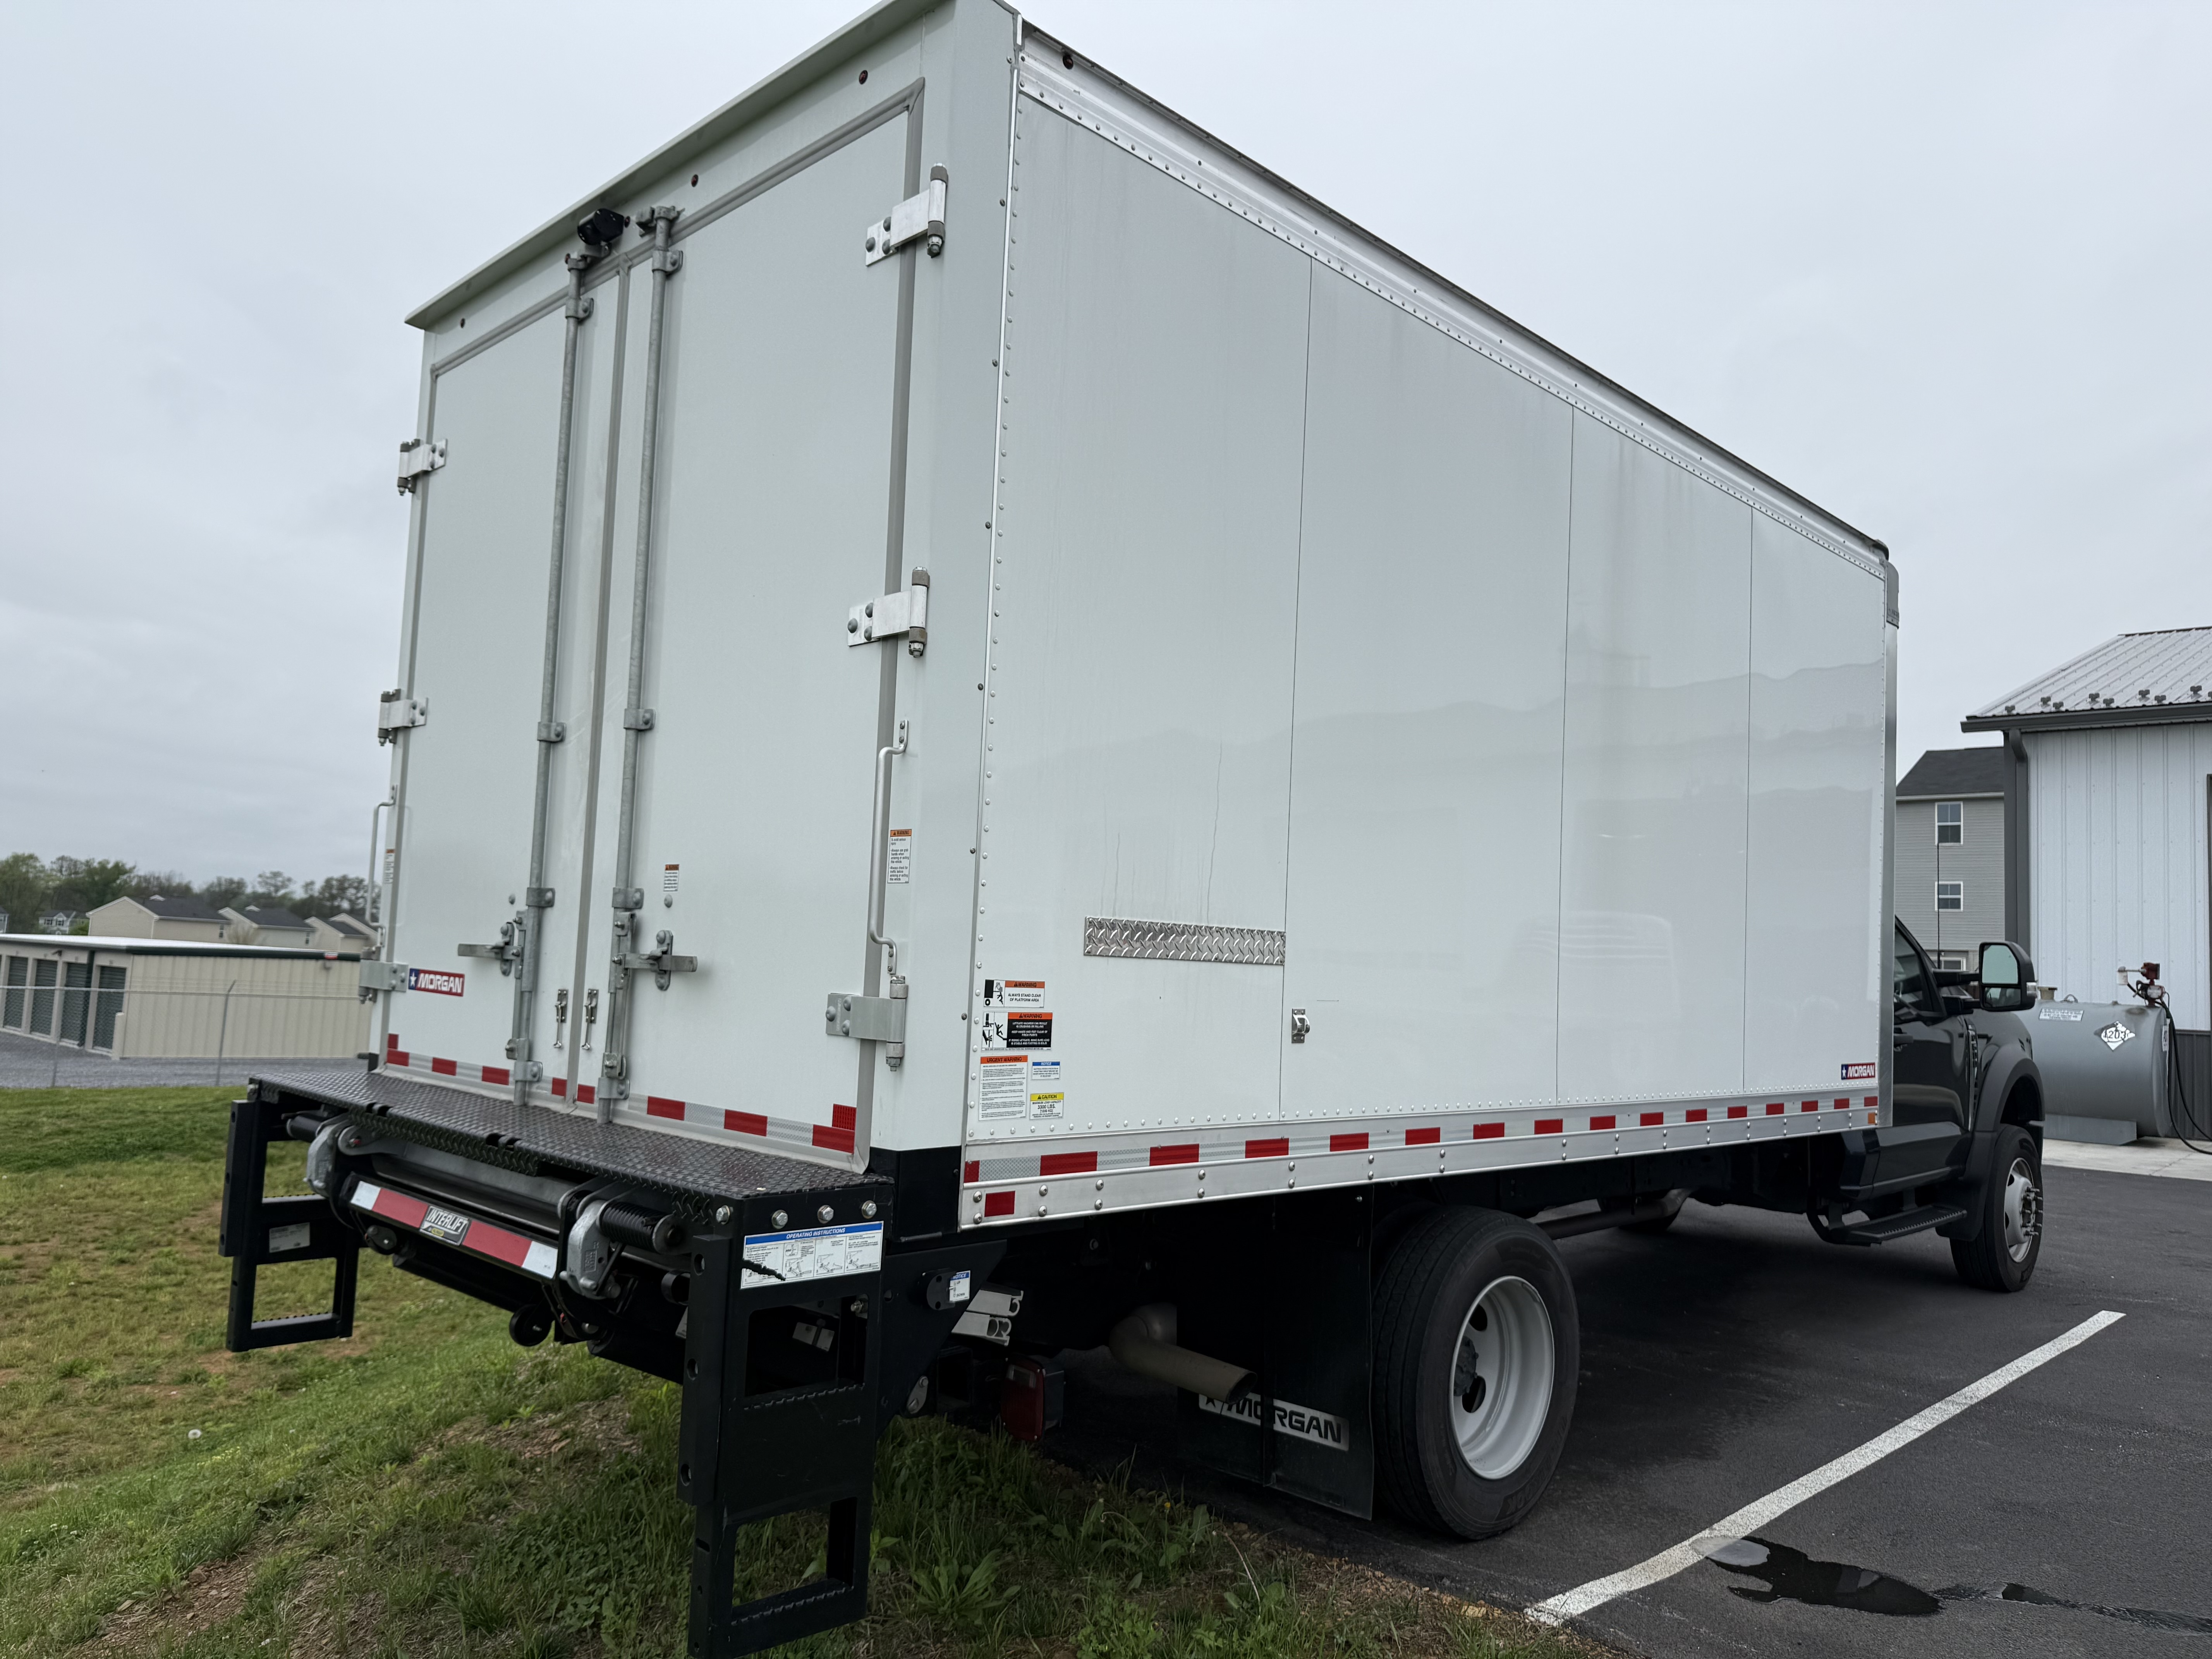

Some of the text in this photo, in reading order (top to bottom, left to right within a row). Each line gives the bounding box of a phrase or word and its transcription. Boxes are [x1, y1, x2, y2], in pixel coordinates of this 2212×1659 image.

[417, 973, 462, 993] MORGAN
[2104, 1030, 2126, 1039] 1203
[1848, 1065, 1874, 1077] MORGAN
[426, 1208, 468, 1232] INTERLIFT
[813, 1228, 846, 1236] INSTRUCTIONS
